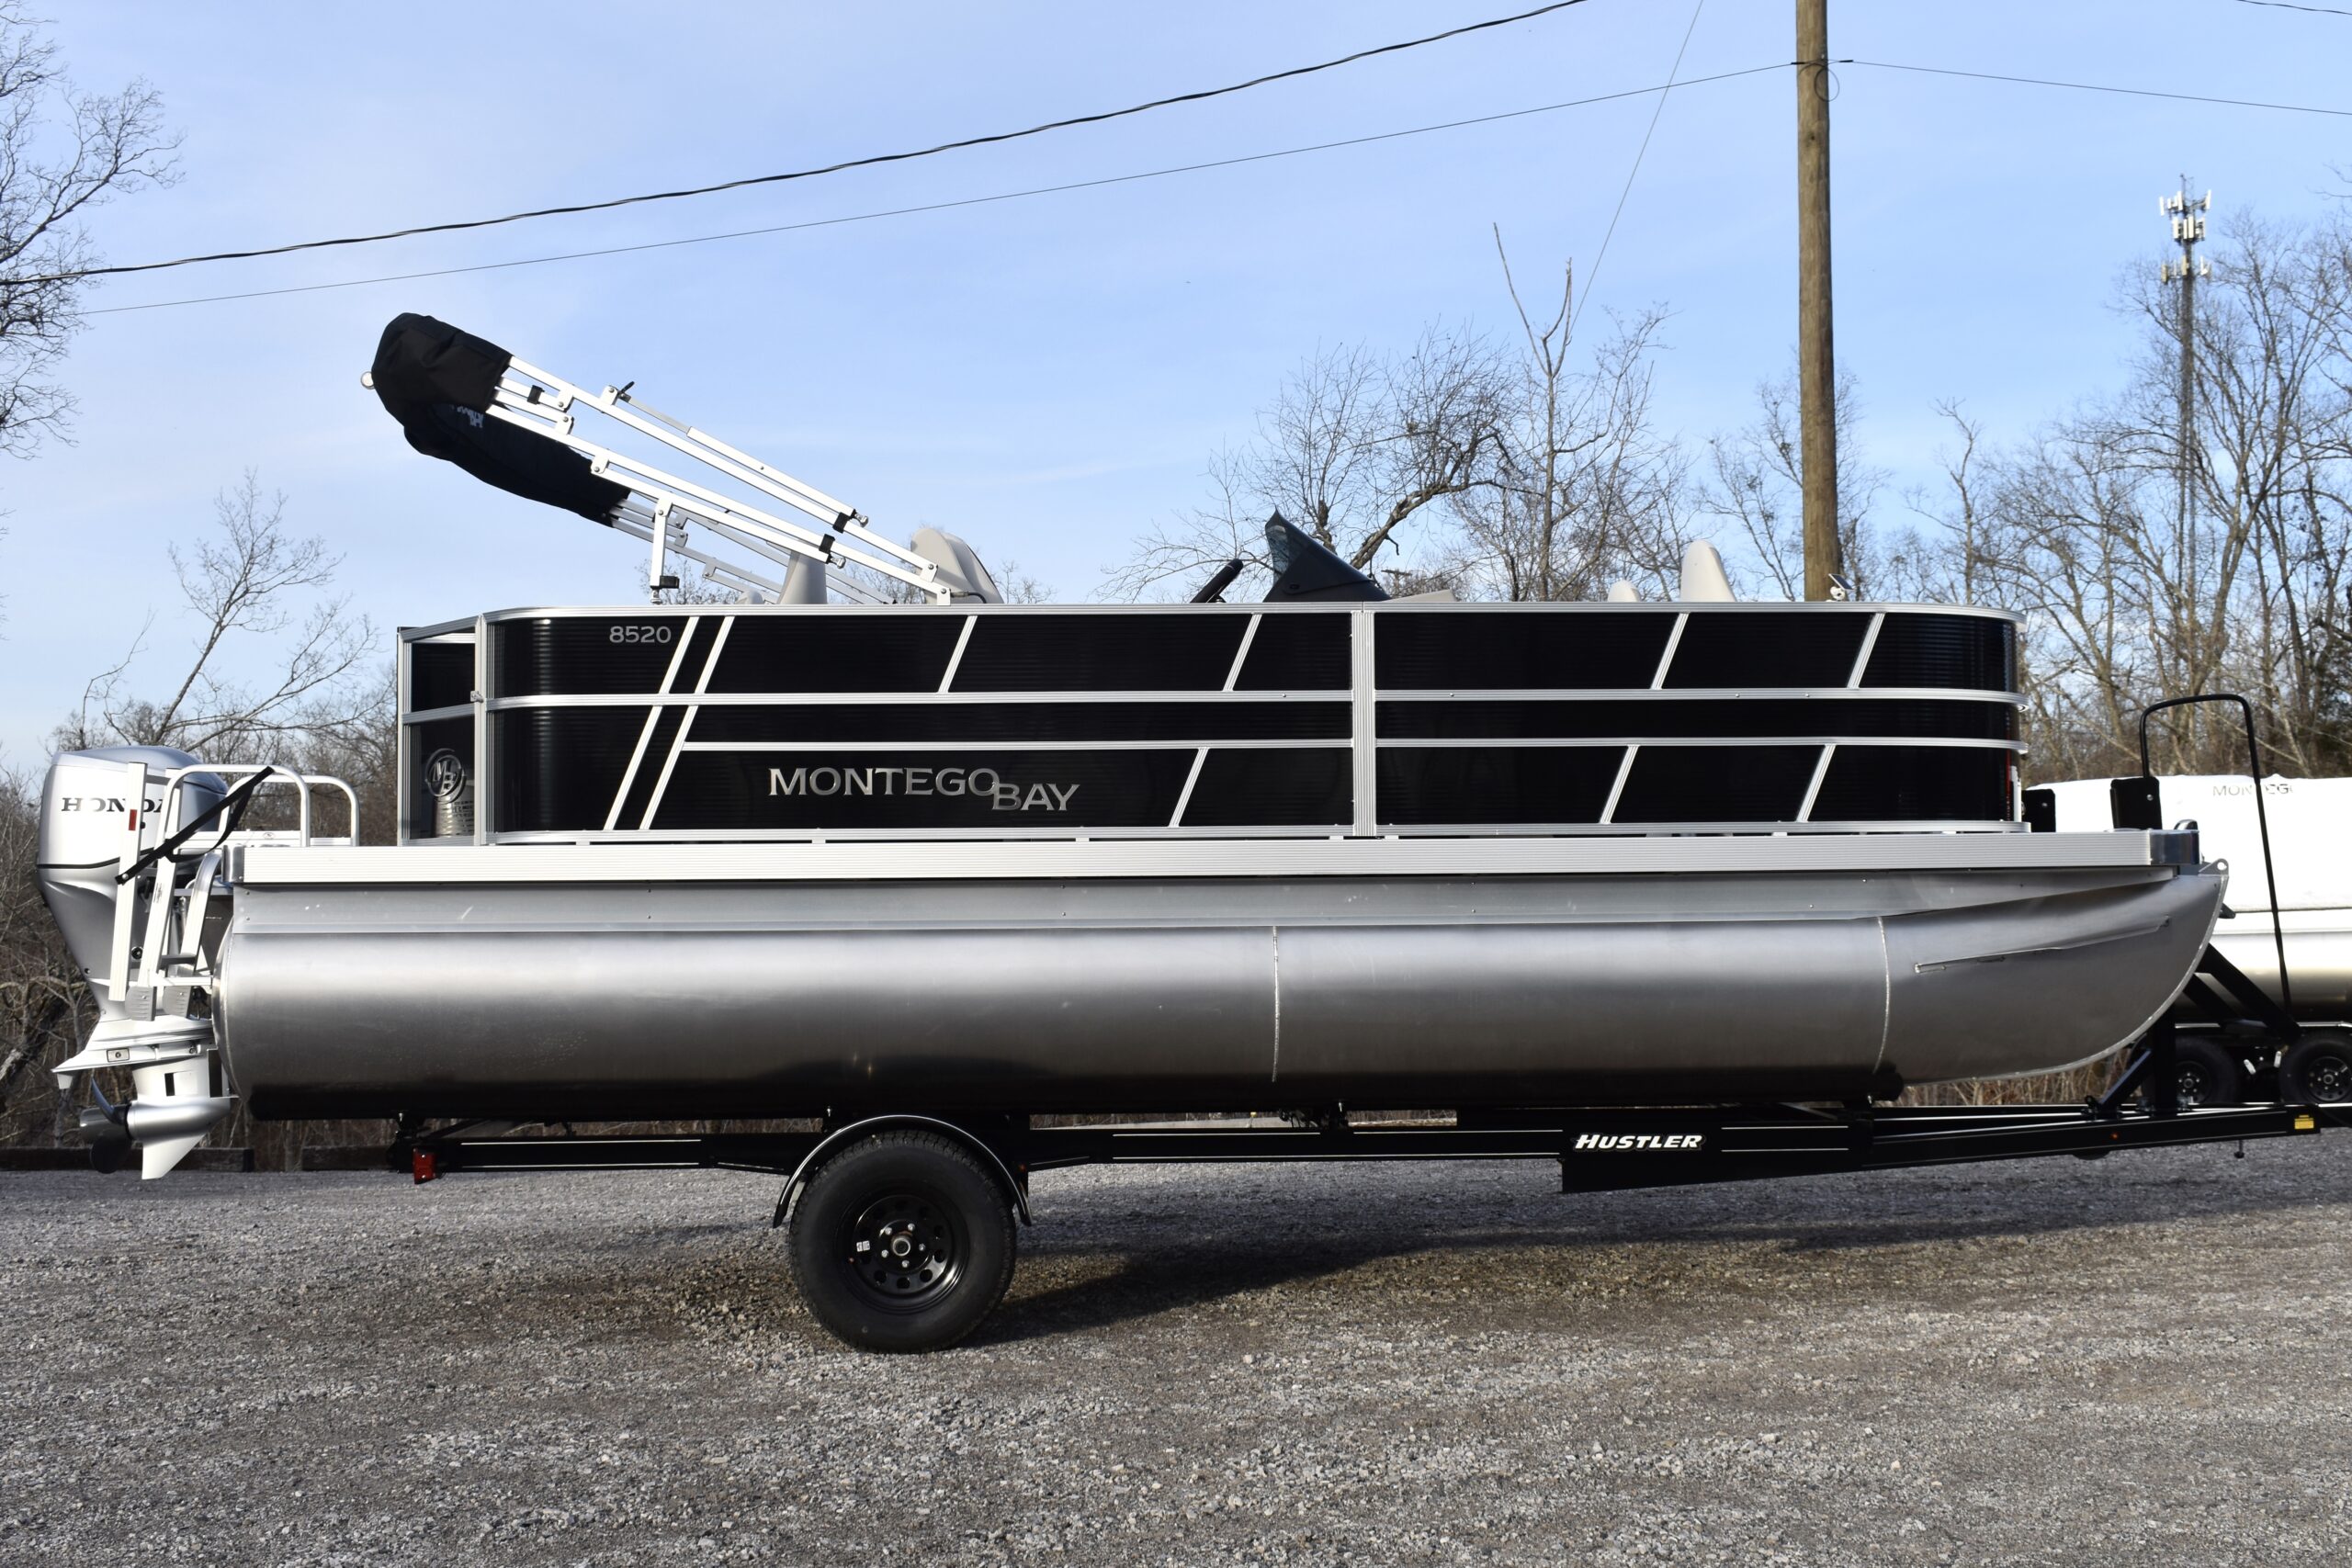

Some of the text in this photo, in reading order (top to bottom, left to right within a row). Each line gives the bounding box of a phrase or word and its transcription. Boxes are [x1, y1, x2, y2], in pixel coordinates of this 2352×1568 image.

[609, 626, 672, 643] 8520
[768, 767, 1080, 811] MONTEGO BAY
[1574, 1134, 1702, 1149] HUSTLER
